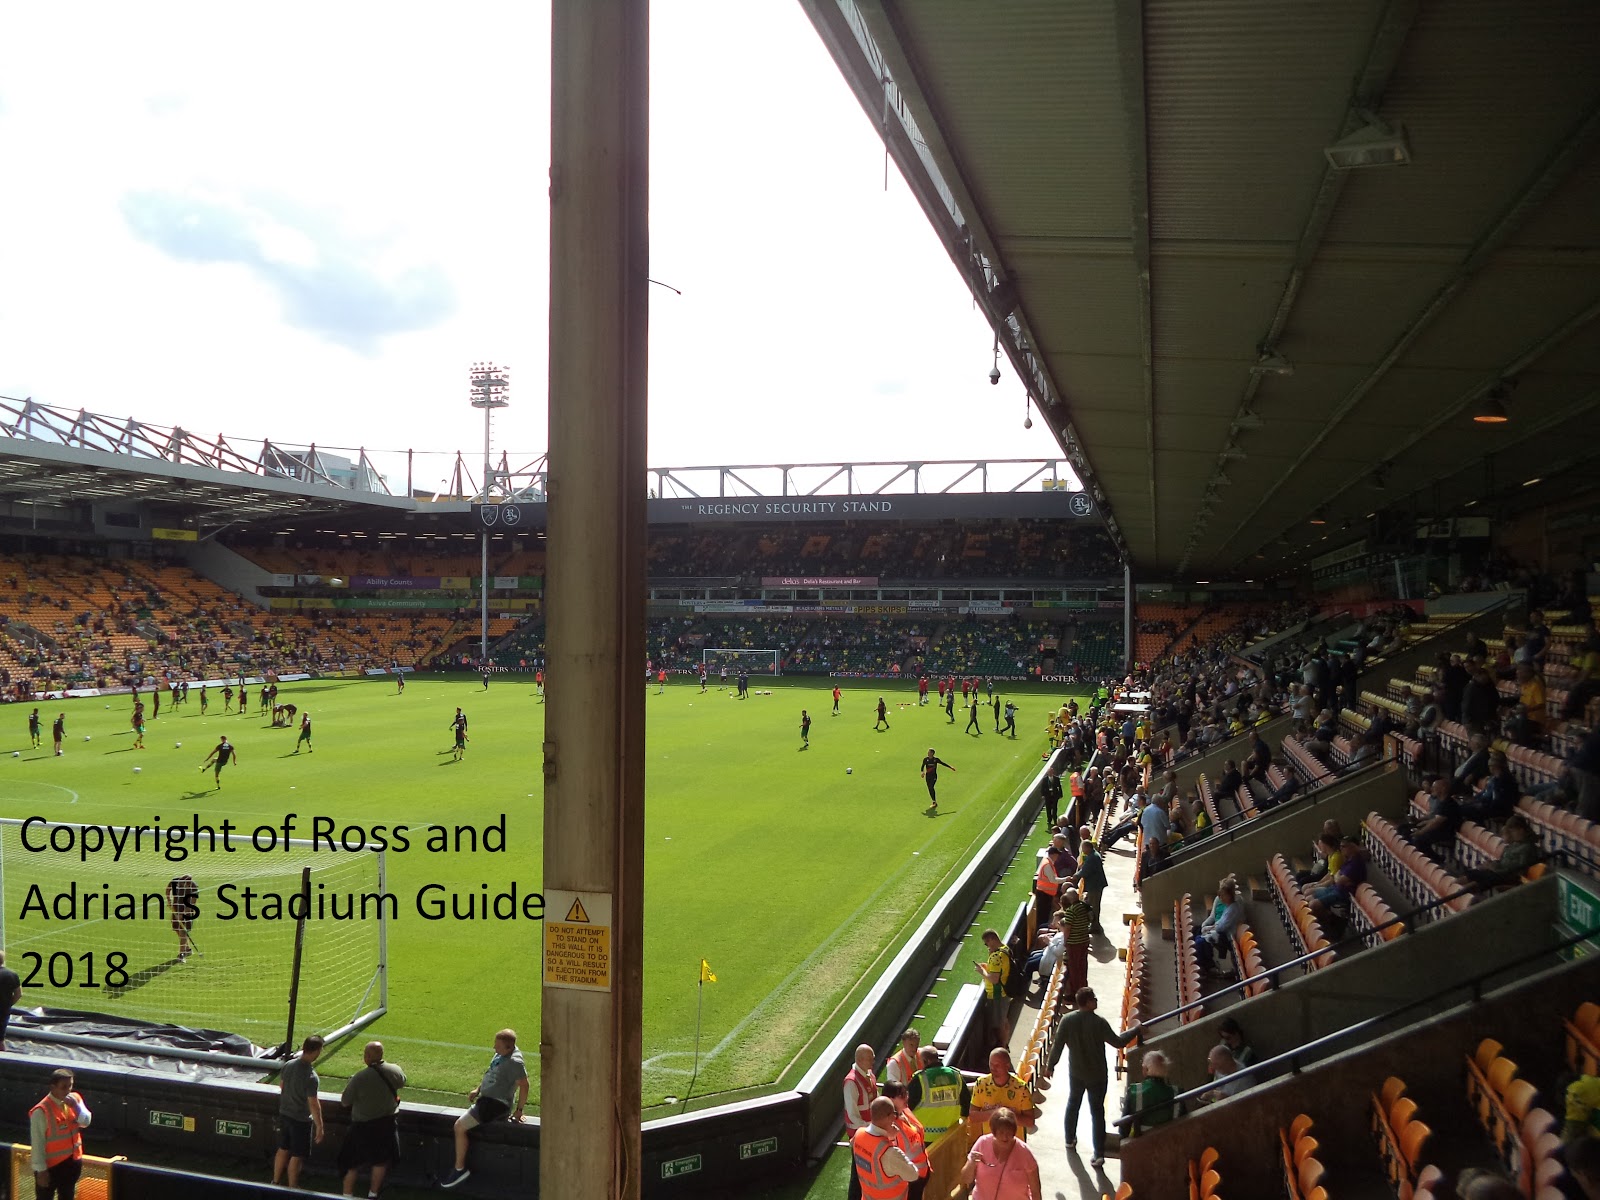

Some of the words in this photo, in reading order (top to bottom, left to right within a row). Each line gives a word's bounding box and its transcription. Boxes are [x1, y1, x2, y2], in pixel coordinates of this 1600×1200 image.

[698, 503, 760, 515] REGENCY
[765, 501, 836, 514] SECURITY
[842, 501, 893, 512] STAND
[366, 578, 388, 587] Ability
[389, 578, 413, 586] Counts
[387, 600, 426, 608] Community
[858, 606, 876, 614] PIPS
[878, 606, 901, 614] SKIPS
[478, 665, 509, 673] FOSTERS
[1041, 674, 1078, 683] FOSTER
[576, 927, 605, 937] ATTEMPT
[566, 936, 587, 944] STAND
[546, 950, 585, 959] DANGEROUS
[583, 961, 607, 969] RESULT
[556, 967, 587, 975] EJECTION
[555, 974, 567, 982] THE
[570, 976, 599, 985] STADIUM.
[757, 1145, 769, 1153] exit
[680, 1164, 693, 1172] exit
